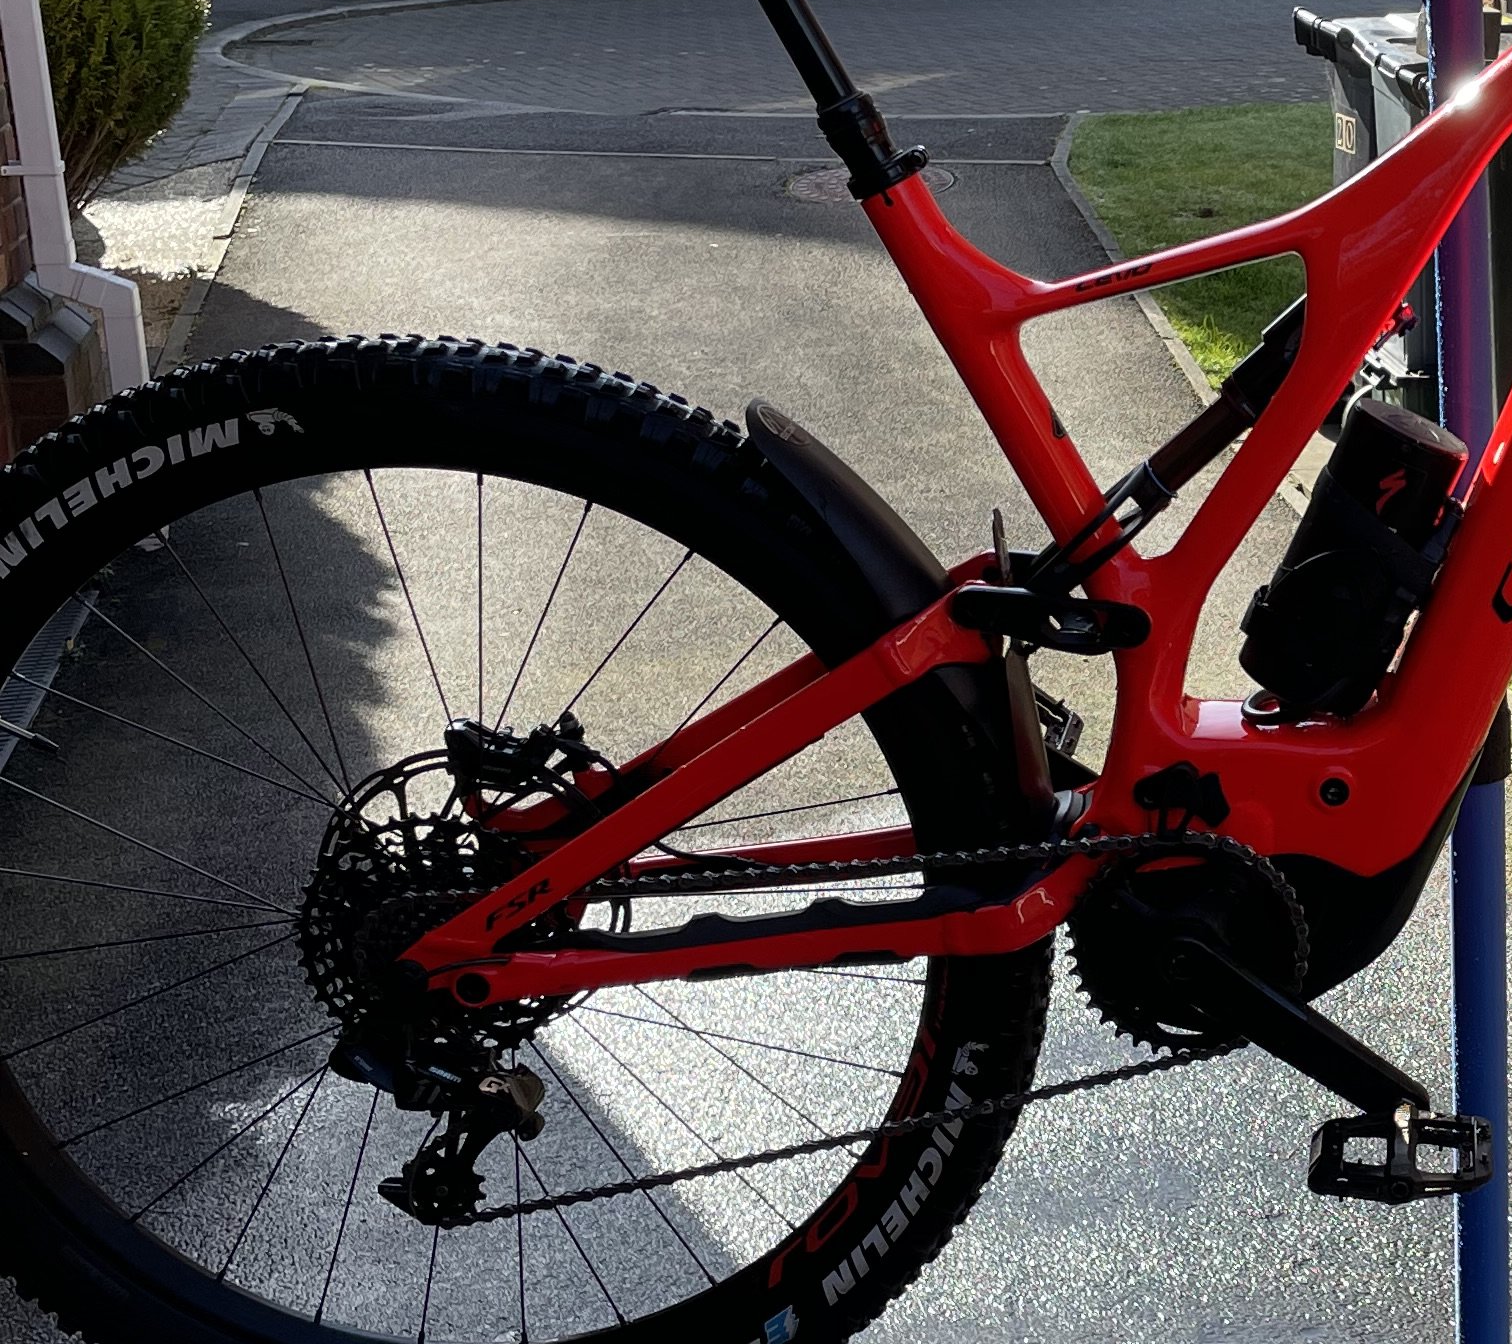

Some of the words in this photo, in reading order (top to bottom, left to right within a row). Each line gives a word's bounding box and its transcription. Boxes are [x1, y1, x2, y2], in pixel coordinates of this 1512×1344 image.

[1336, 116, 1355, 151] 20
[0, 417, 240, 580] MICHELIN
[486, 878, 552, 933] FSR
[822, 1082, 972, 1307] MICHELIN
